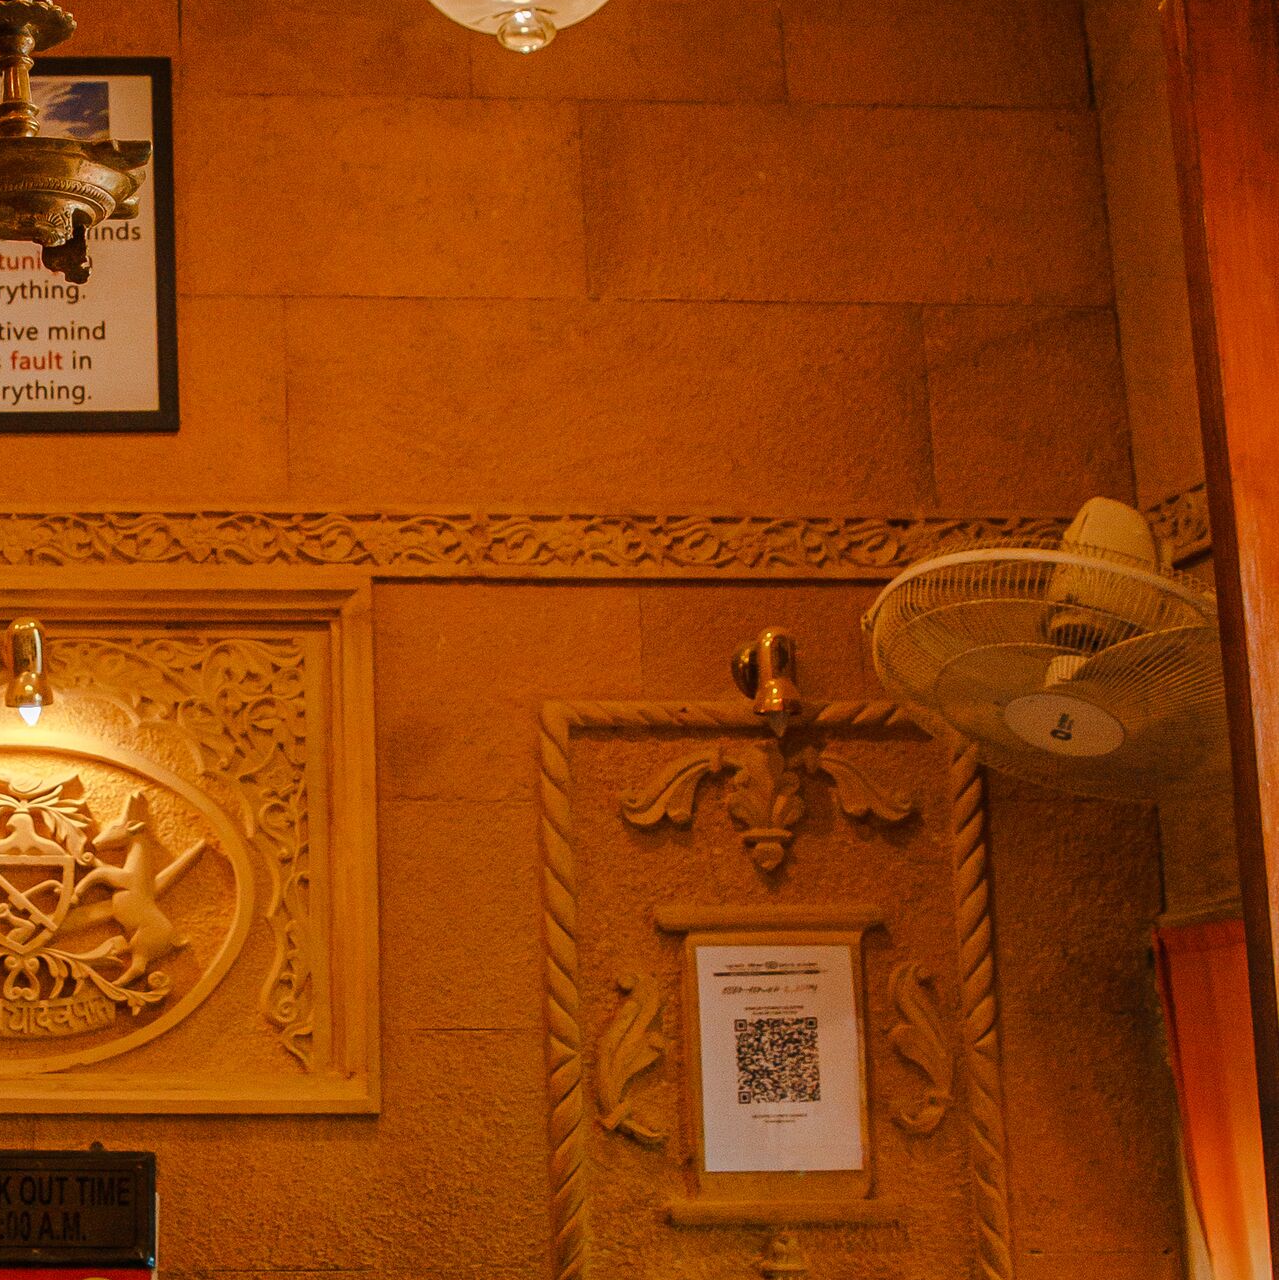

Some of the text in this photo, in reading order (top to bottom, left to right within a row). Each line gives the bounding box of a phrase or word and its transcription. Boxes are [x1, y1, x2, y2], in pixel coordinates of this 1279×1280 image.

[48, 320, 106, 341] mind
[10, 351, 63, 370] fault
[72, 351, 92, 370] in
[20, 1176, 69, 1206] OUT
[75, 1177, 131, 1207] TIME
